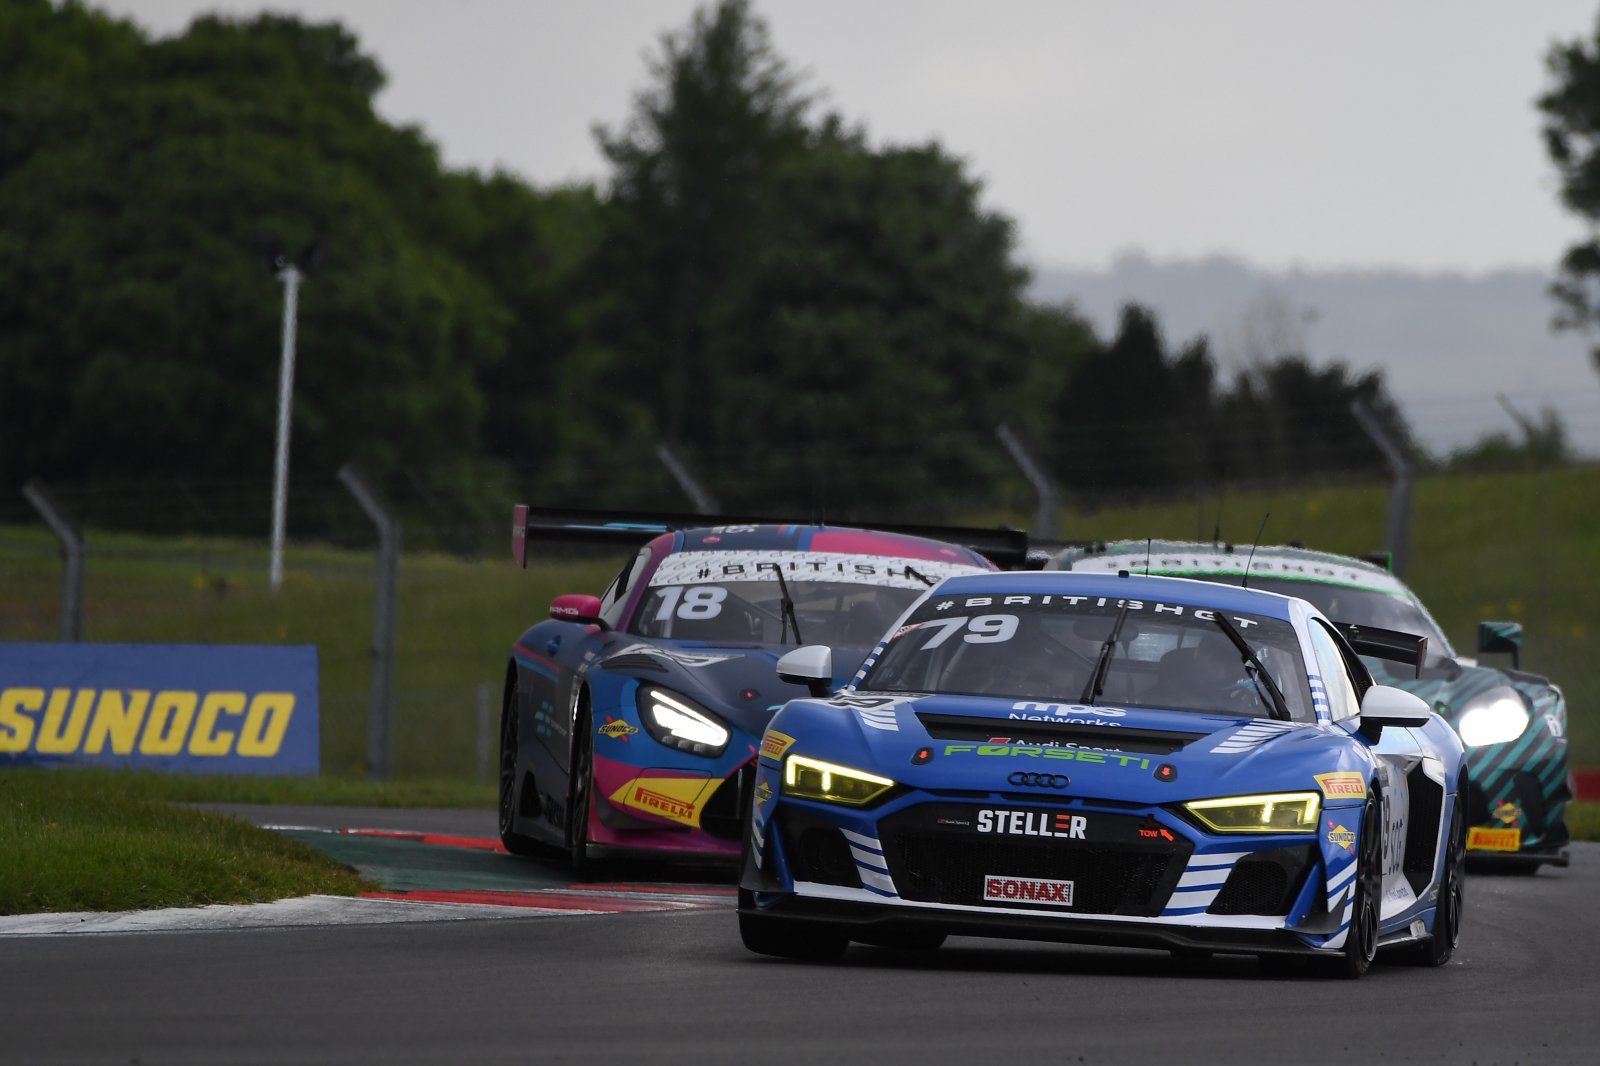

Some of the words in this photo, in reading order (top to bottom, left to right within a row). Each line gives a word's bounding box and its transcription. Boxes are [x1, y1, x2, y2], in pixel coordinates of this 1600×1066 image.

[655, 585, 728, 621] 18
[936, 595, 1259, 628] #BRITISHGT
[914, 614, 1020, 650] 79
[0, 687, 297, 757] SUNOCO
[1012, 701, 1127, 717] mps
[1321, 777, 1365, 795] PIRELLI
[634, 786, 696, 819] PIRELLI
[977, 809, 1088, 840] STELLER
[1139, 829, 1158, 838] TOW
[1329, 832, 1356, 843] SUNOCO
[986, 878, 1067, 903] SONAX
